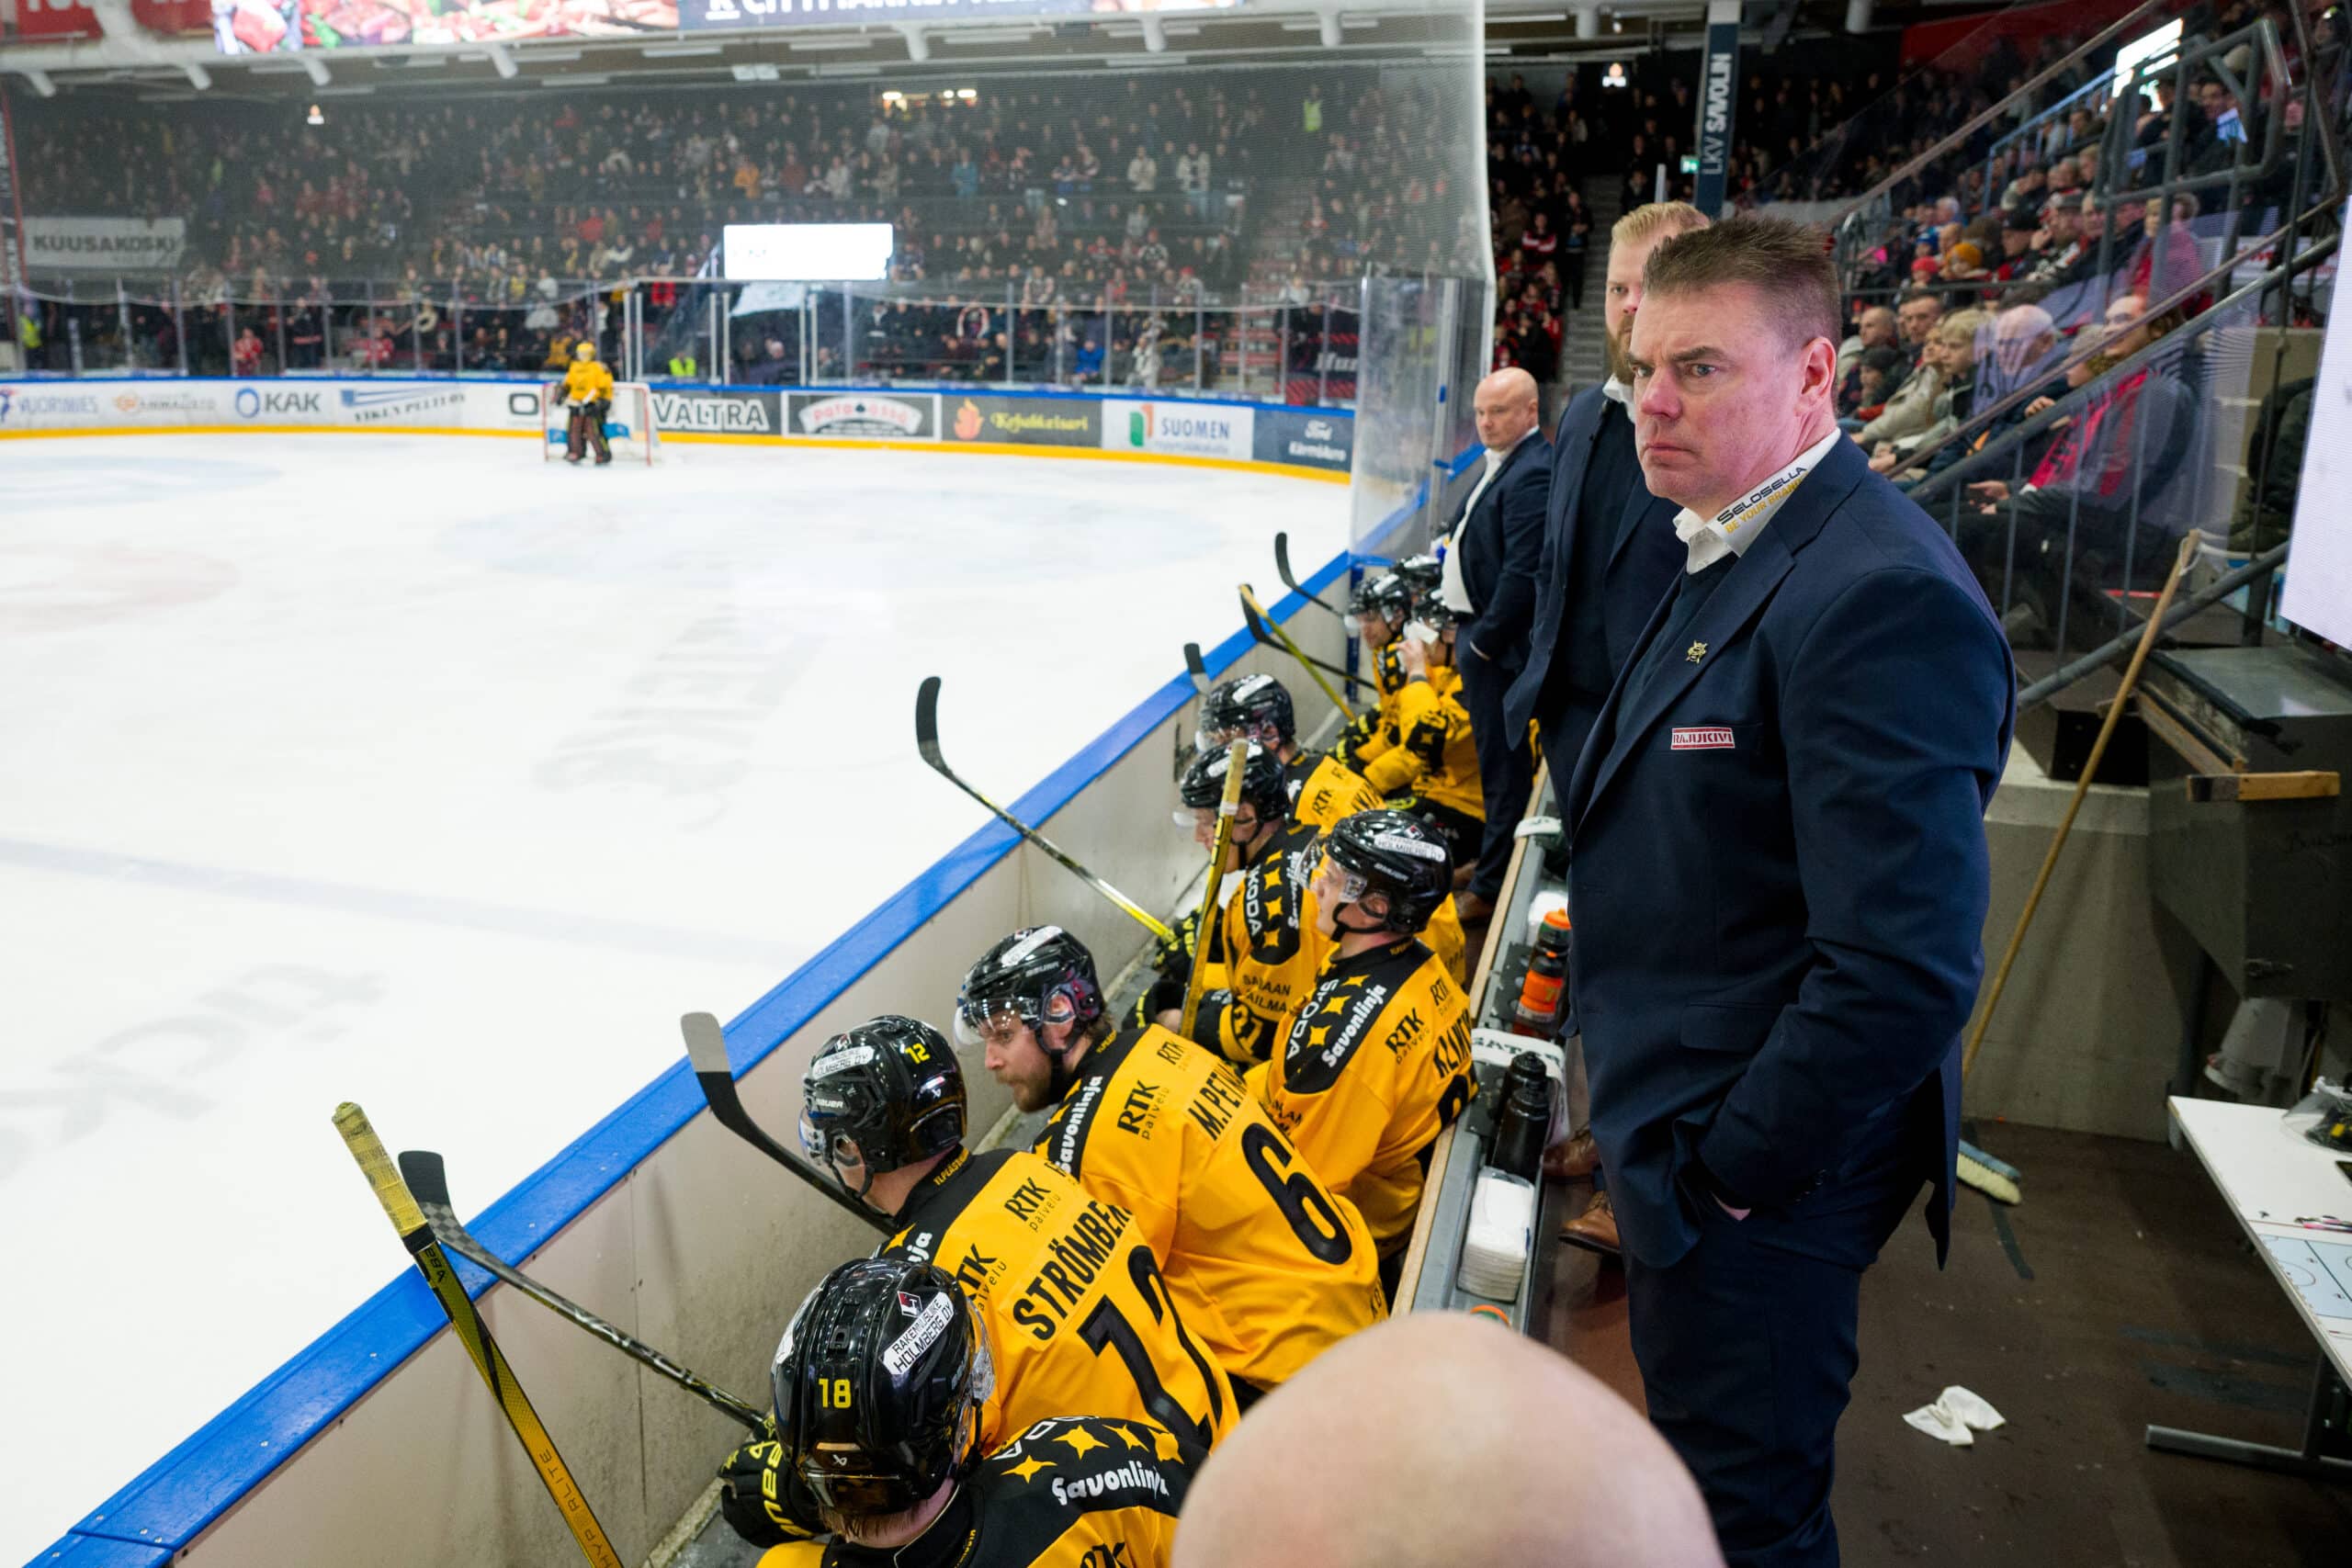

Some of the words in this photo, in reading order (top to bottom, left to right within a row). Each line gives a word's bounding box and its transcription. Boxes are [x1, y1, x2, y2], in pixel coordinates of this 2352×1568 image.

[1702, 136, 1724, 175] LKV
[32, 234, 177, 254] KUUSAKOSKI
[265, 391, 322, 413] KAK
[651, 394, 770, 430] VALTRA
[1160, 417, 1231, 440] SUOMEN
[1716, 466, 1808, 525] SELOSELLA
[1724, 521, 1741, 536] BE
[1743, 502, 1770, 525] YOUR
[1246, 864, 1262, 936] KODA
[1322, 984, 1387, 1068] Savonlinja
[1385, 1008, 1425, 1055] RTK
[904, 1043, 931, 1064] 12
[1157, 1042, 1185, 1066] RTK
[1116, 1079, 1160, 1135] RTK
[1004, 1177, 1052, 1223] RTK
[1029, 1193, 1062, 1233] palvelu
[1241, 1122, 1352, 1266] 6
[956, 1243, 998, 1304] TK
[978, 1260, 1008, 1312] alvelu
[893, 1315, 944, 1373] HOLMBERG
[941, 1302, 954, 1321] OY
[819, 1378, 852, 1409] 18
[539, 1449, 615, 1568] HYPRLITE
